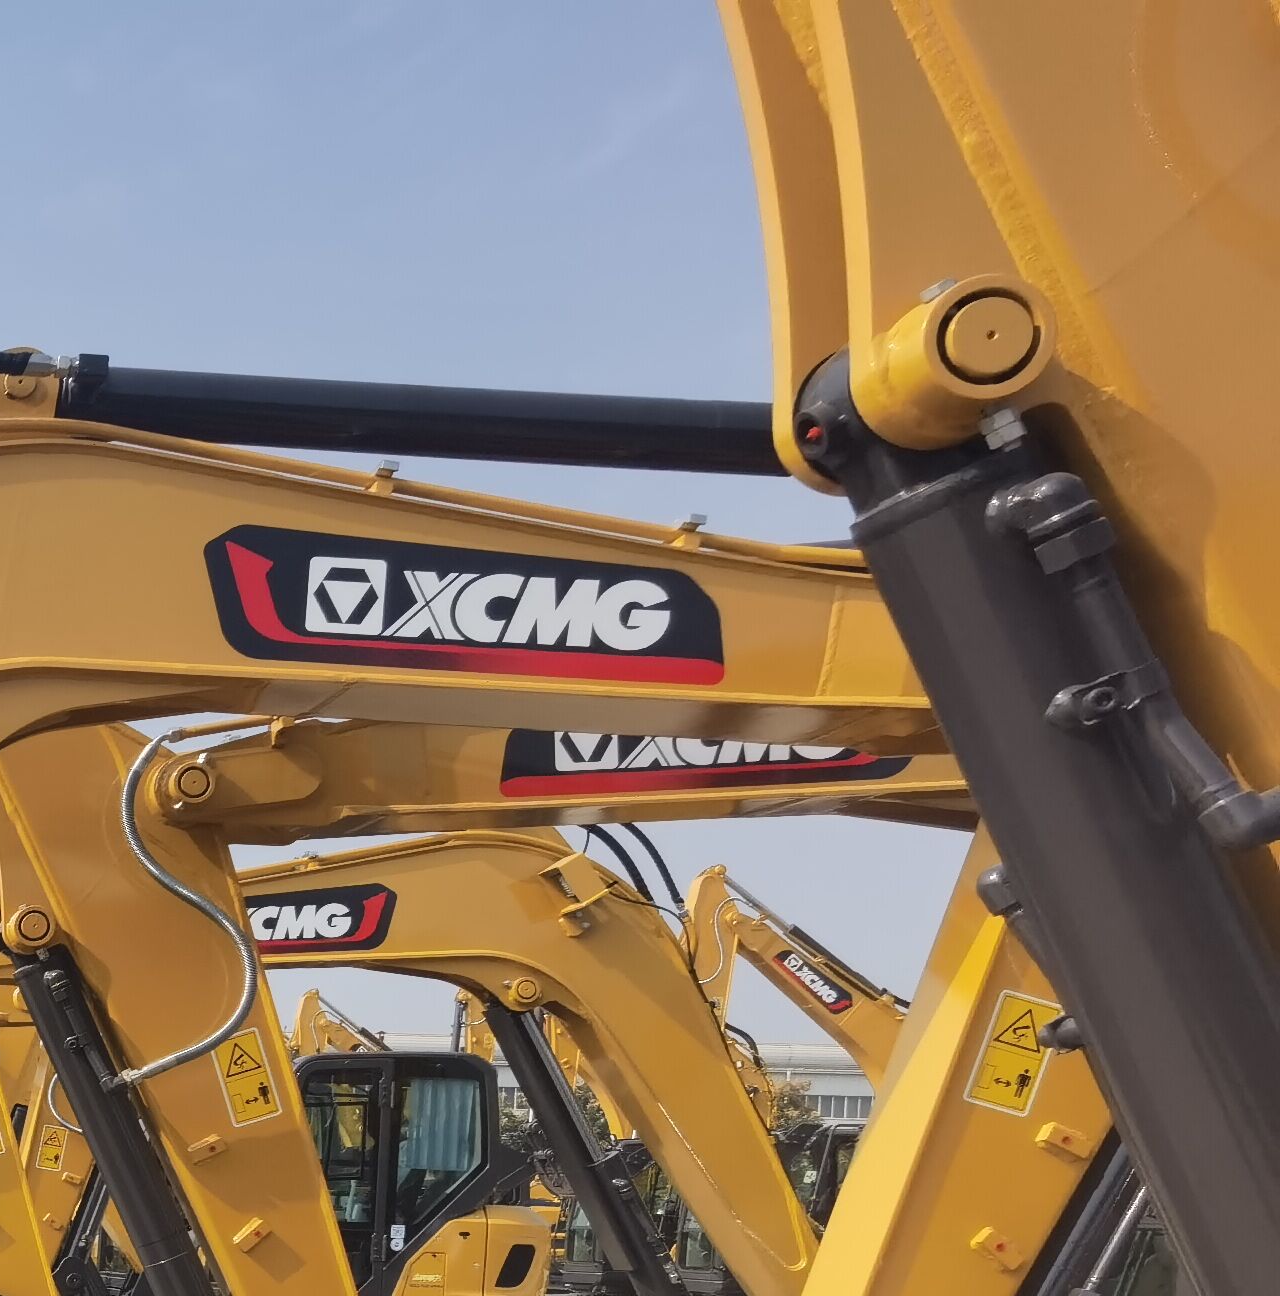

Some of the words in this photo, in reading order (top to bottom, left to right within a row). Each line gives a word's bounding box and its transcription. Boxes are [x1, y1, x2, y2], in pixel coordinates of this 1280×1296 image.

[381, 570, 671, 651] XCMG
[247, 902, 352, 941] CMG
[793, 965, 838, 1004] XCMG
